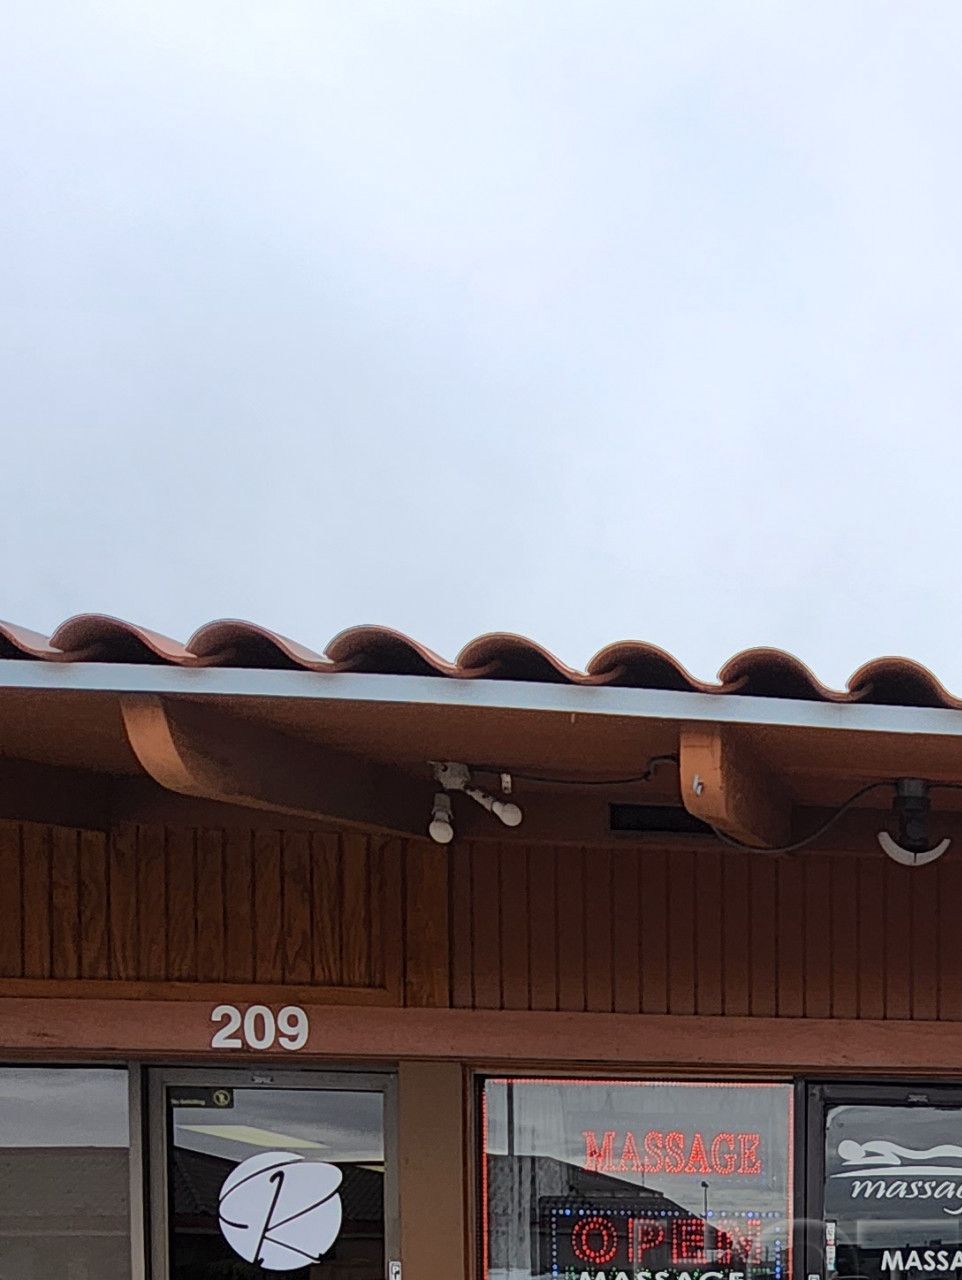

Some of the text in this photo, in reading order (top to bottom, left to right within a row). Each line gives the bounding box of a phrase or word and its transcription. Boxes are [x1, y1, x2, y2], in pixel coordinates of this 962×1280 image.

[210, 1004, 310, 1051] 209
[582, 1129, 763, 1175] MASSAGE
[571, 1215, 762, 1265] OPEN
